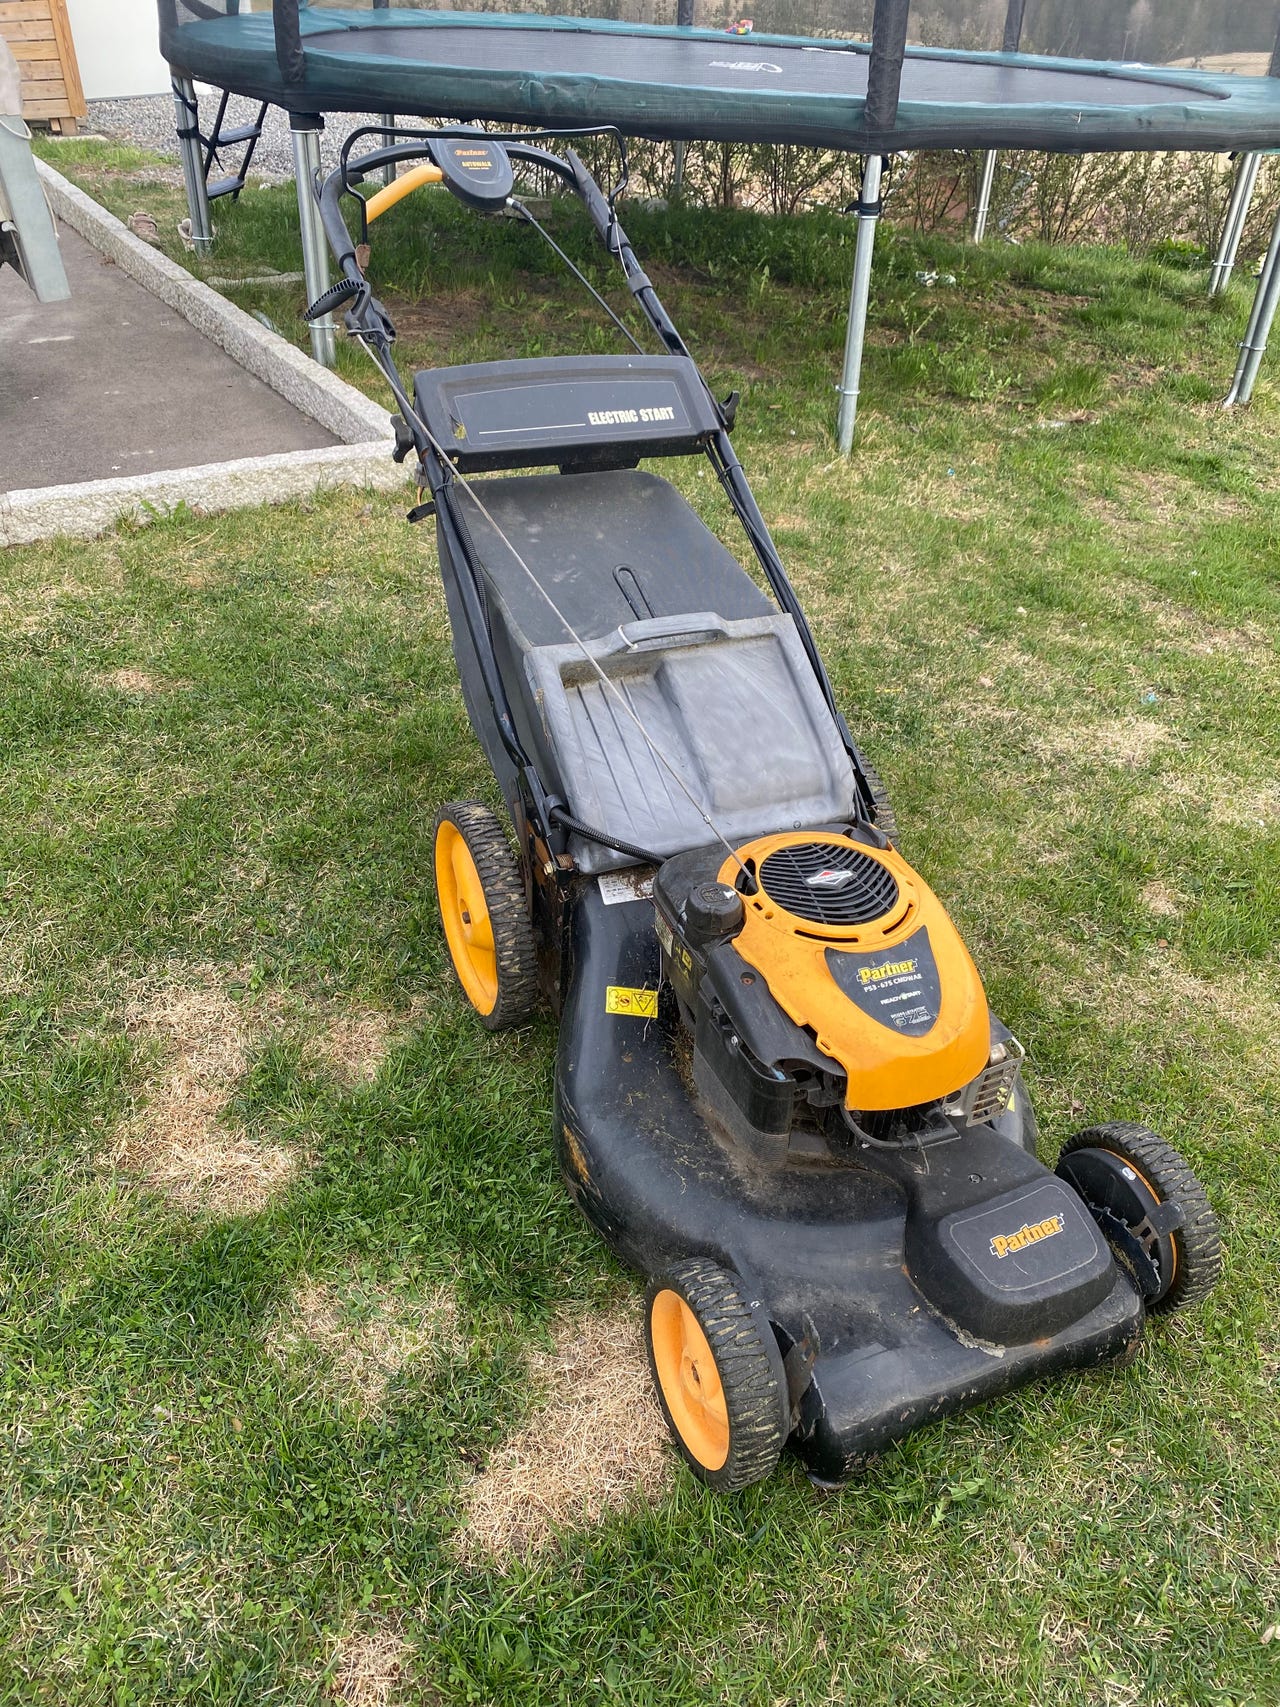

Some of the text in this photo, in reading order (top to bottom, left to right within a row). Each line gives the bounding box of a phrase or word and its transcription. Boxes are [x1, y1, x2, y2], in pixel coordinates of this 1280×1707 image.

[587, 407, 674, 425] ELECTRIC START
[858, 960, 916, 984] Partner
[991, 1215, 1063, 1258] Partner
